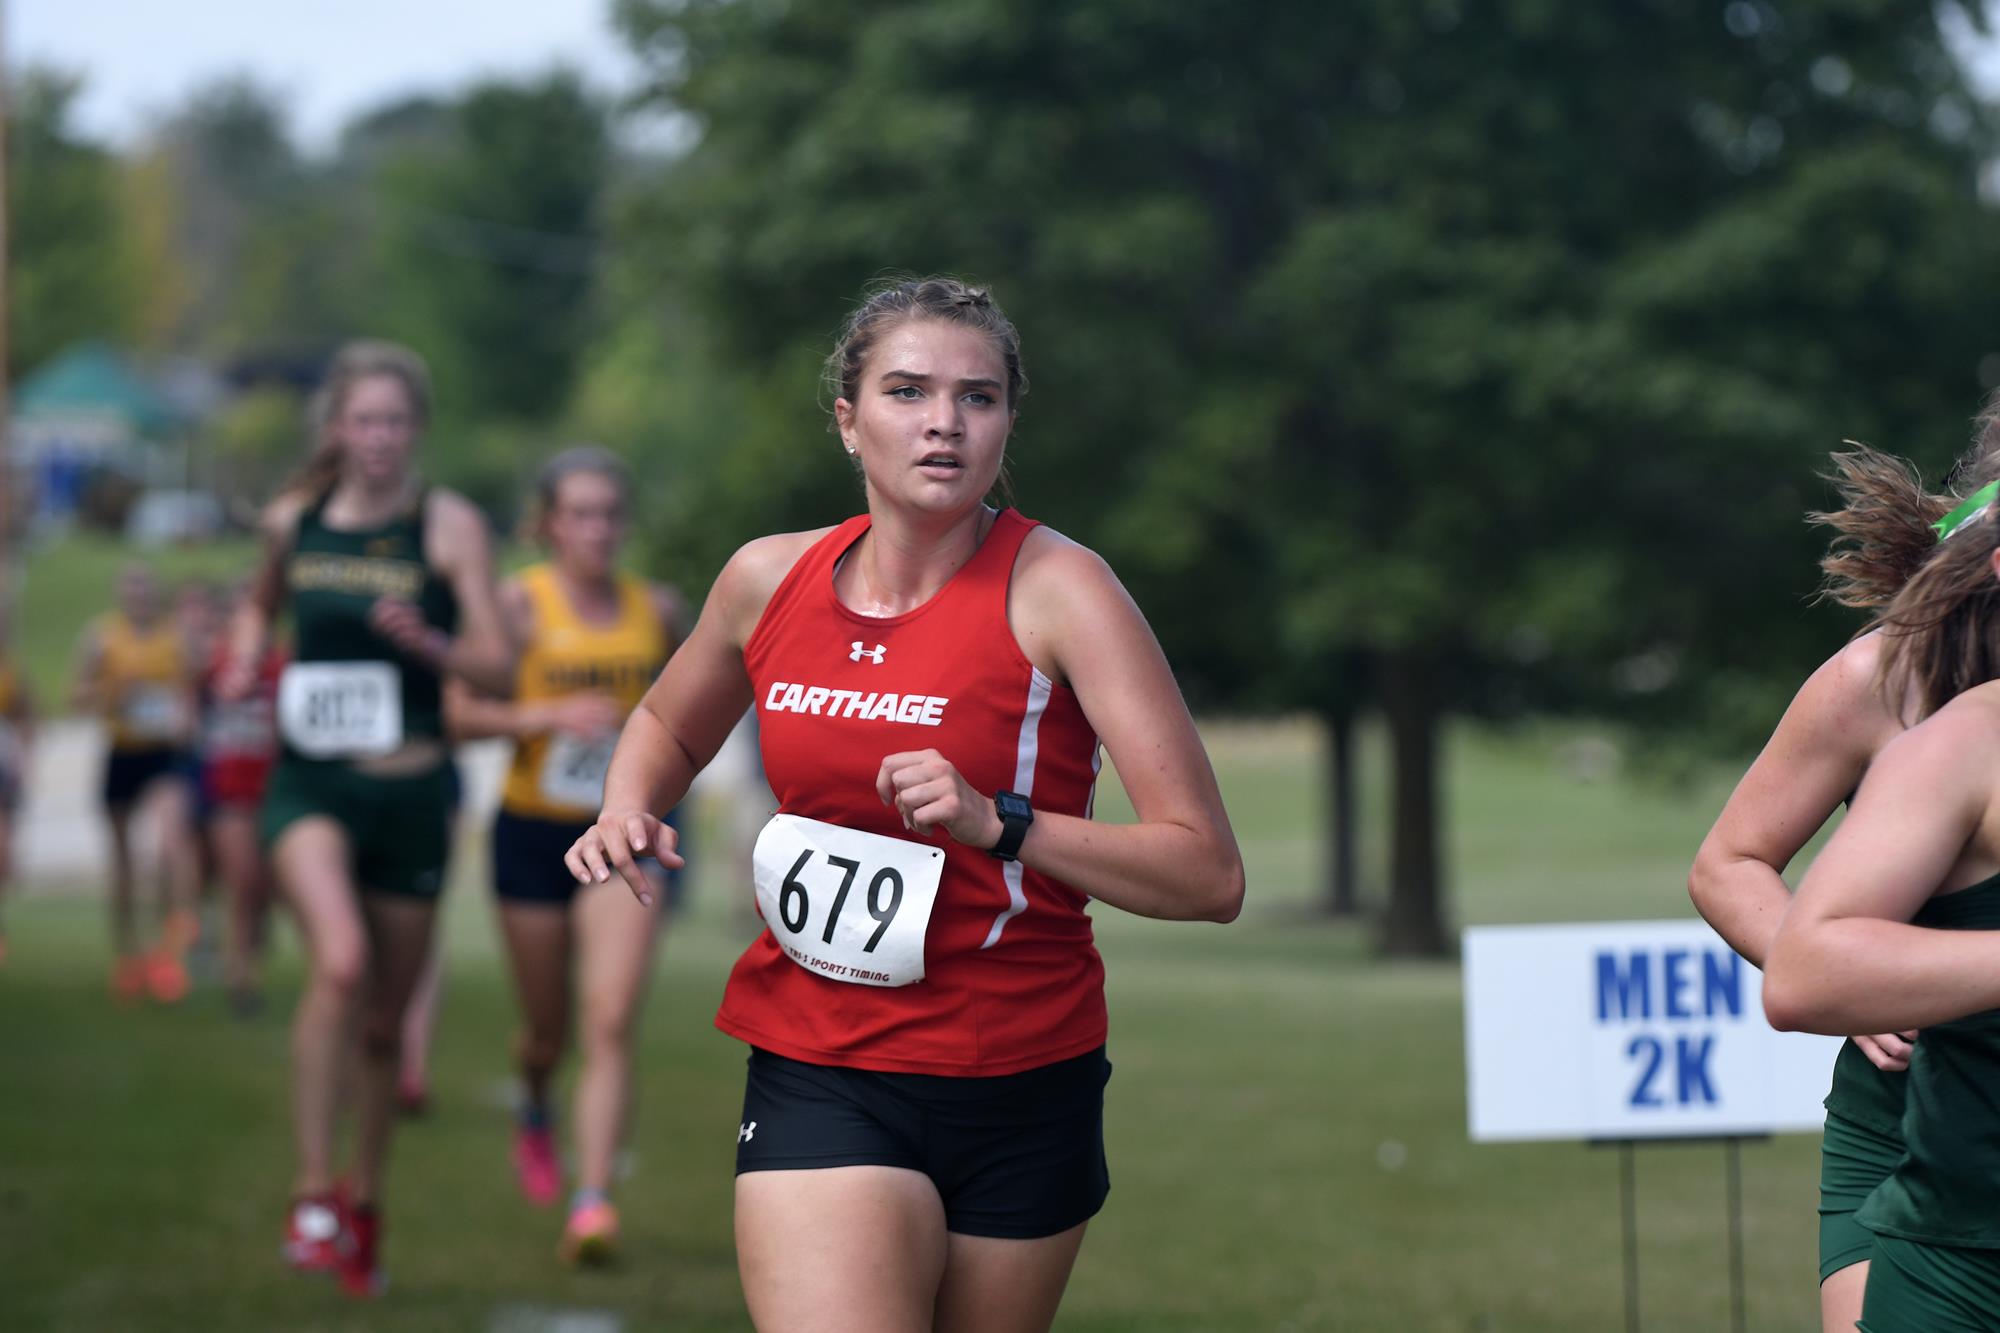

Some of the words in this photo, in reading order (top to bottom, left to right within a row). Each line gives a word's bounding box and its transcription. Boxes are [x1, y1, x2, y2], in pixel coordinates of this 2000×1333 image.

[765, 681, 949, 726] CARTHAGE
[779, 849, 904, 953] 679
[811, 957, 847, 975] SPORTS
[849, 968, 890, 982] TIMING
[1595, 950, 1742, 1021] MEN
[1626, 1034, 1718, 1106] 2K
